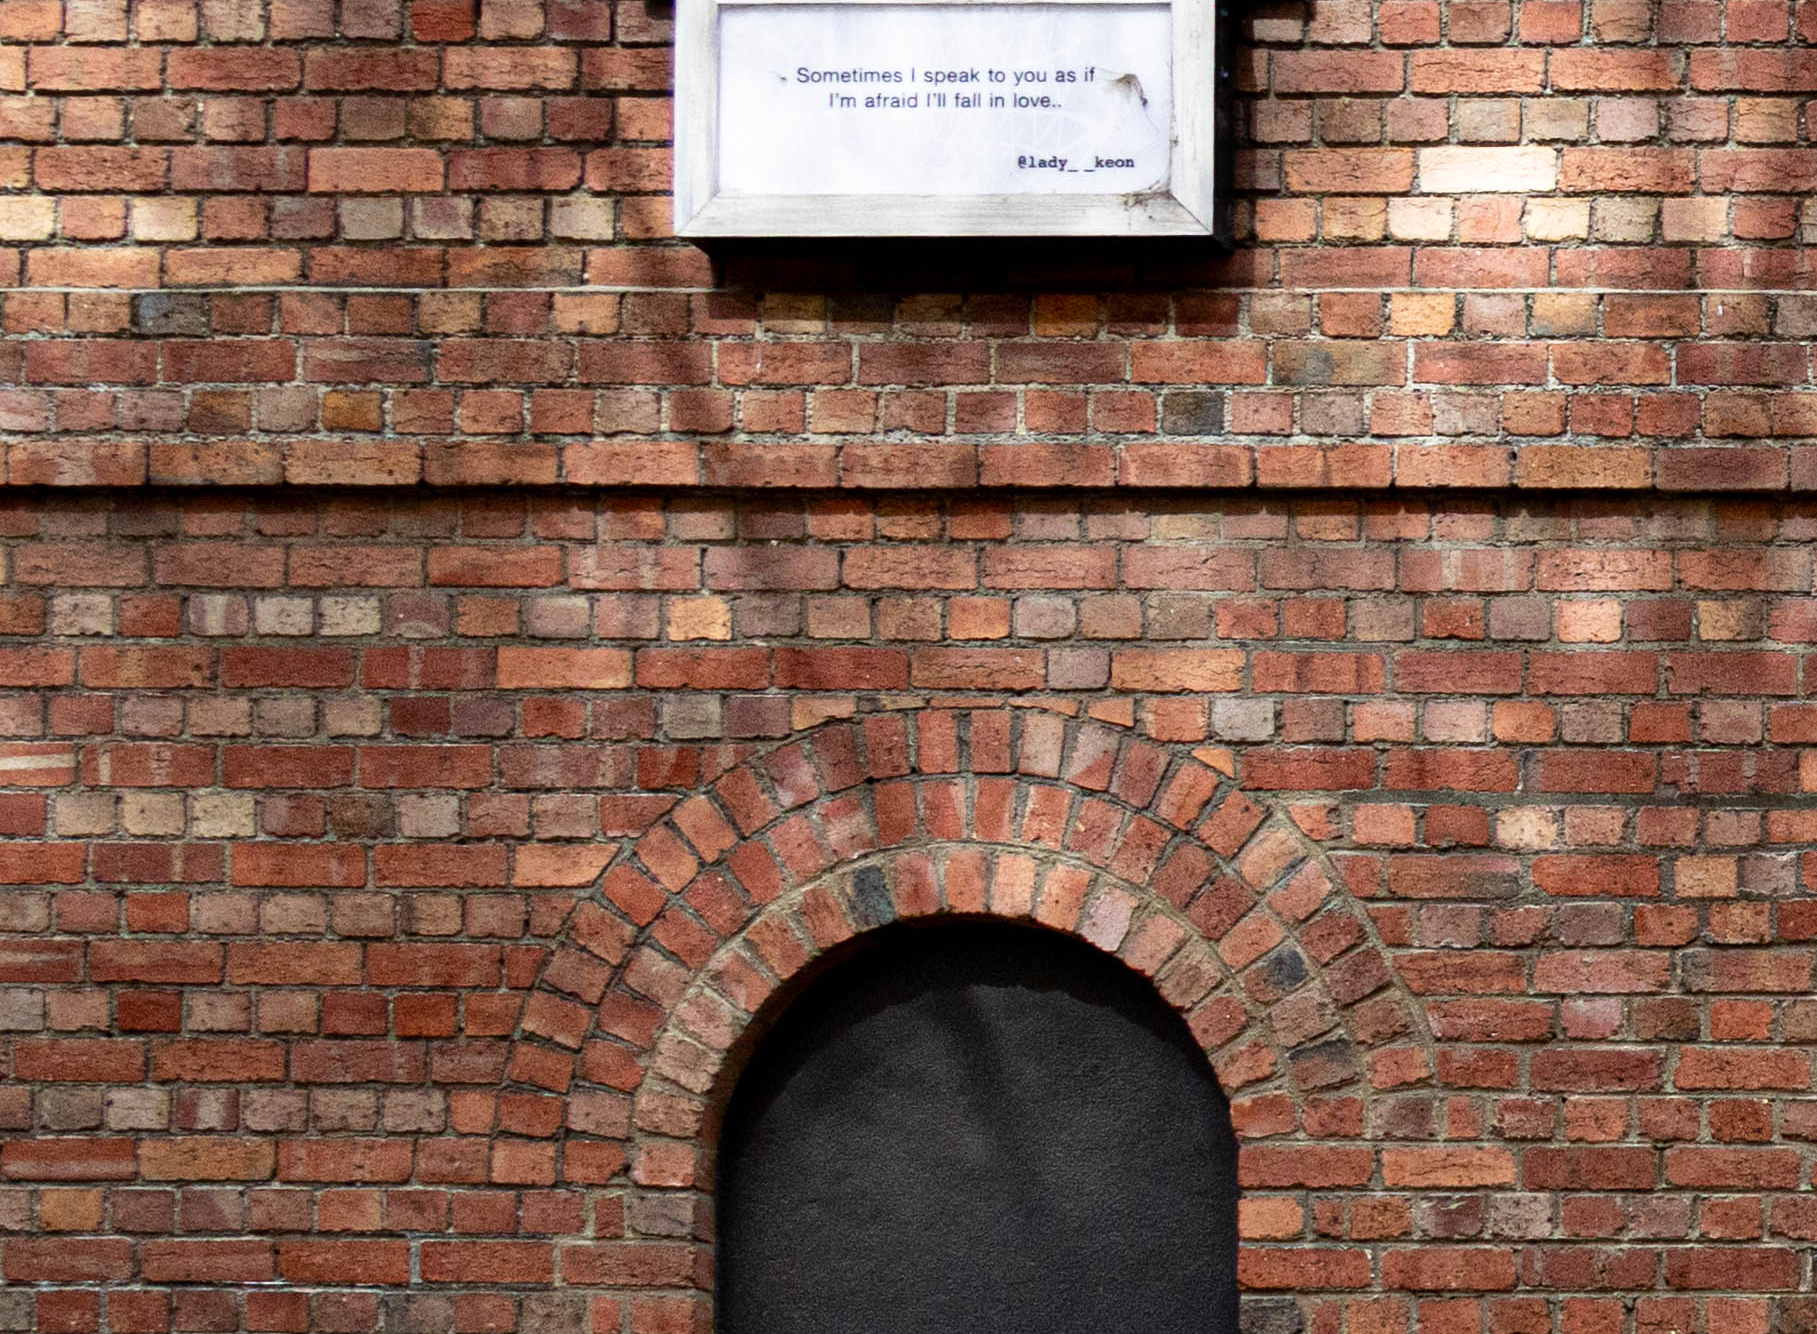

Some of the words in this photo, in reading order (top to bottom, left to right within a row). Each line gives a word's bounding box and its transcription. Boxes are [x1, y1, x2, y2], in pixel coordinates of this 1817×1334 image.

[796, 66, 903, 84] Sometimes
[910, 66, 917, 84] I
[923, 66, 981, 87] speak
[987, 67, 1006, 84] to
[1012, 70, 1048, 87] you
[1054, 69, 1078, 84] as
[1083, 66, 1097, 83] if
[829, 92, 857, 108] I'm
[864, 92, 919, 109] afraid
[926, 92, 947, 108] I'll
[953, 91, 982, 109] fall
[989, 92, 1006, 108] in
[1012, 92, 1062, 109] love..
